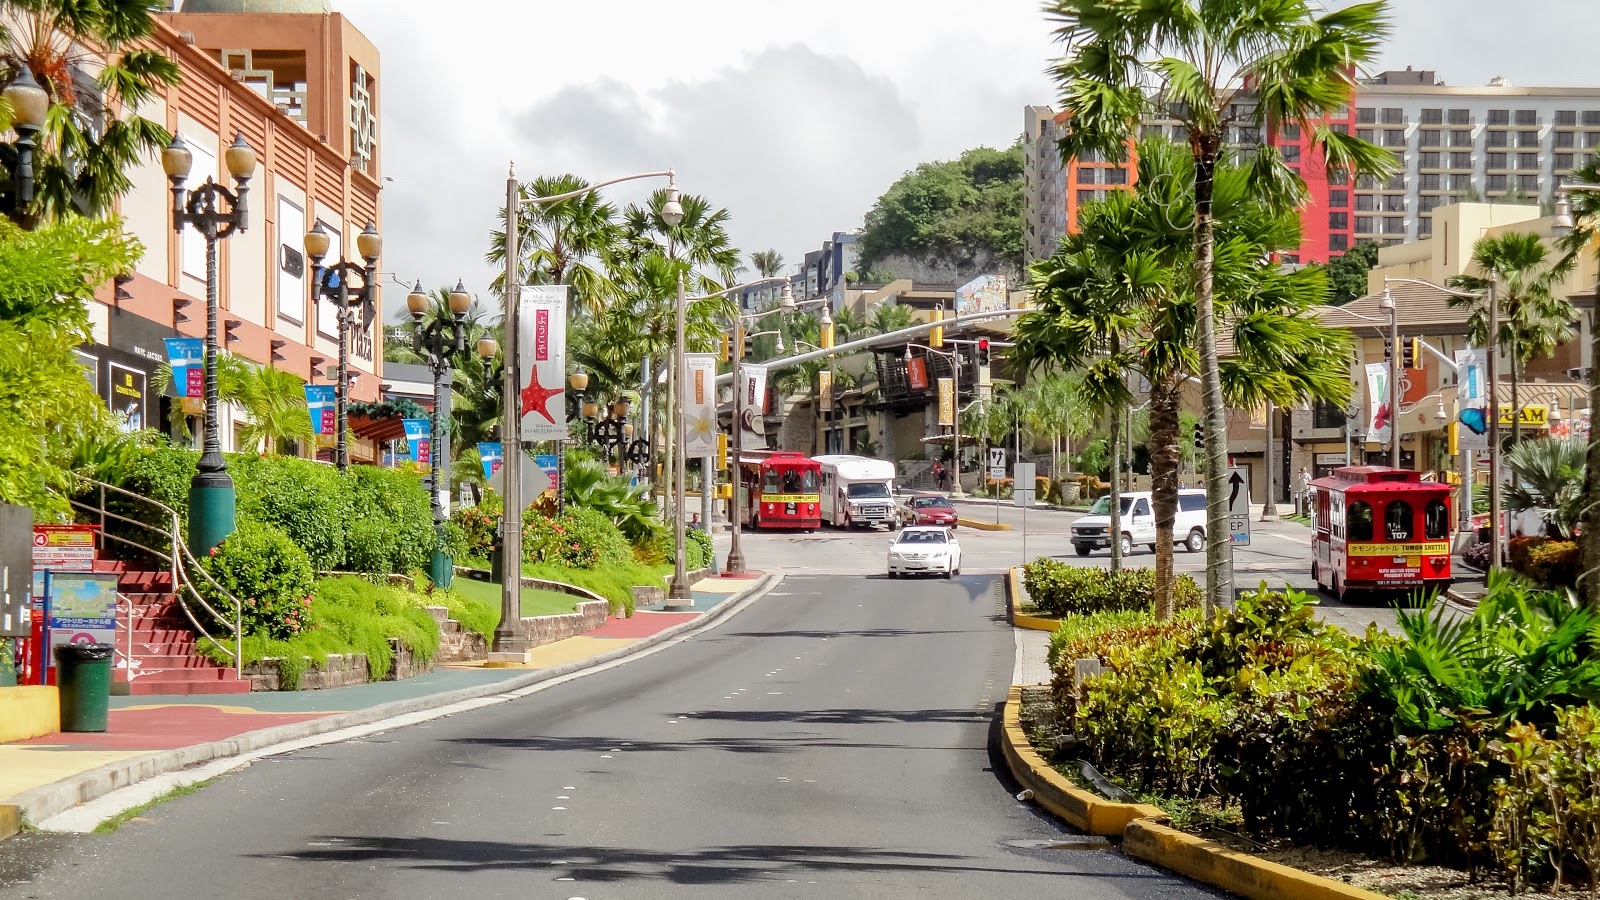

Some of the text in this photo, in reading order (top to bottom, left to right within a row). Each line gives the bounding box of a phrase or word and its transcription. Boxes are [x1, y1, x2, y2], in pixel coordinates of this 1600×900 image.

[134, 345, 163, 362] MARC JACOBS
[1499, 409, 1544, 421] UAM
[1230, 522, 1244, 531] EP
